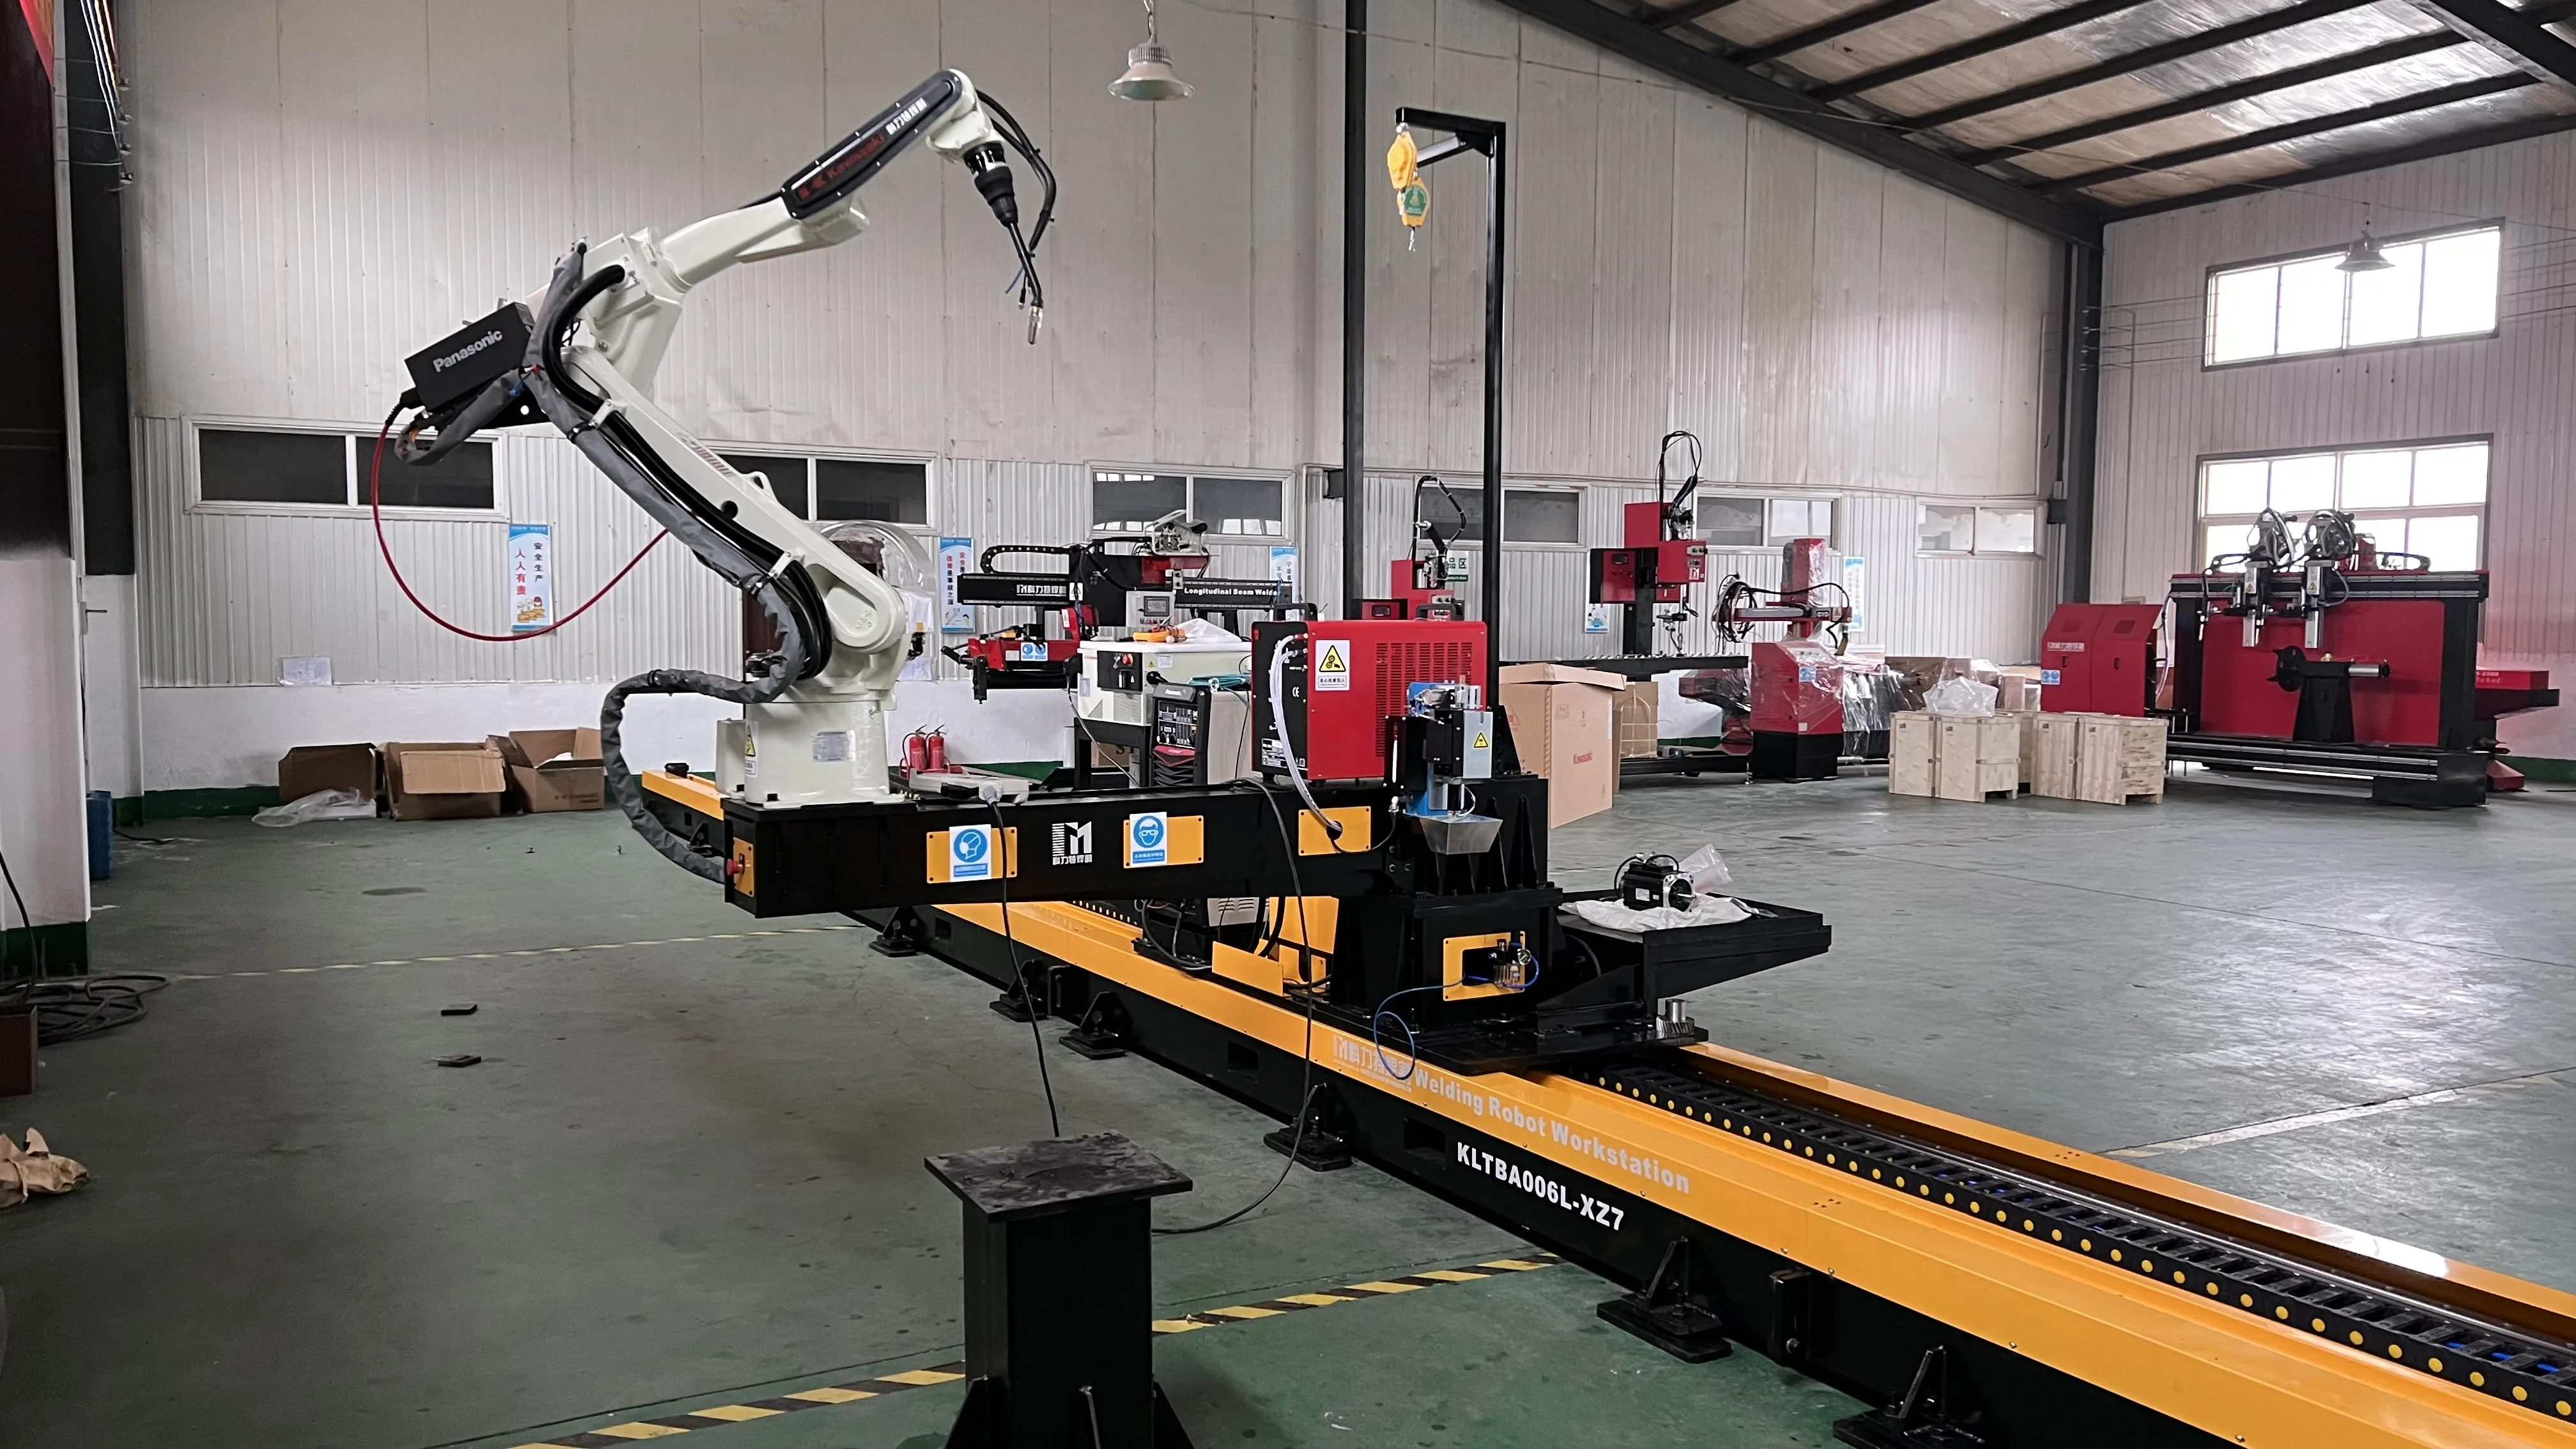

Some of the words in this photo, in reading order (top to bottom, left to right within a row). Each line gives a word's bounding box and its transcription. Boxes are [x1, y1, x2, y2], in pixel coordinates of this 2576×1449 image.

[433, 330, 503, 372] Panasonic
[515, 548, 527, 595] 人人有责
[533, 542, 543, 583] 安全生产
[1184, 587, 1232, 596] Longitudinal
[1414, 1068, 1483, 1116] Welding
[1489, 1095, 1545, 1137] Robot
[1551, 1119, 1690, 1194] Workstation
[1457, 1141, 1625, 1231] KLTBA006L-XZ7
